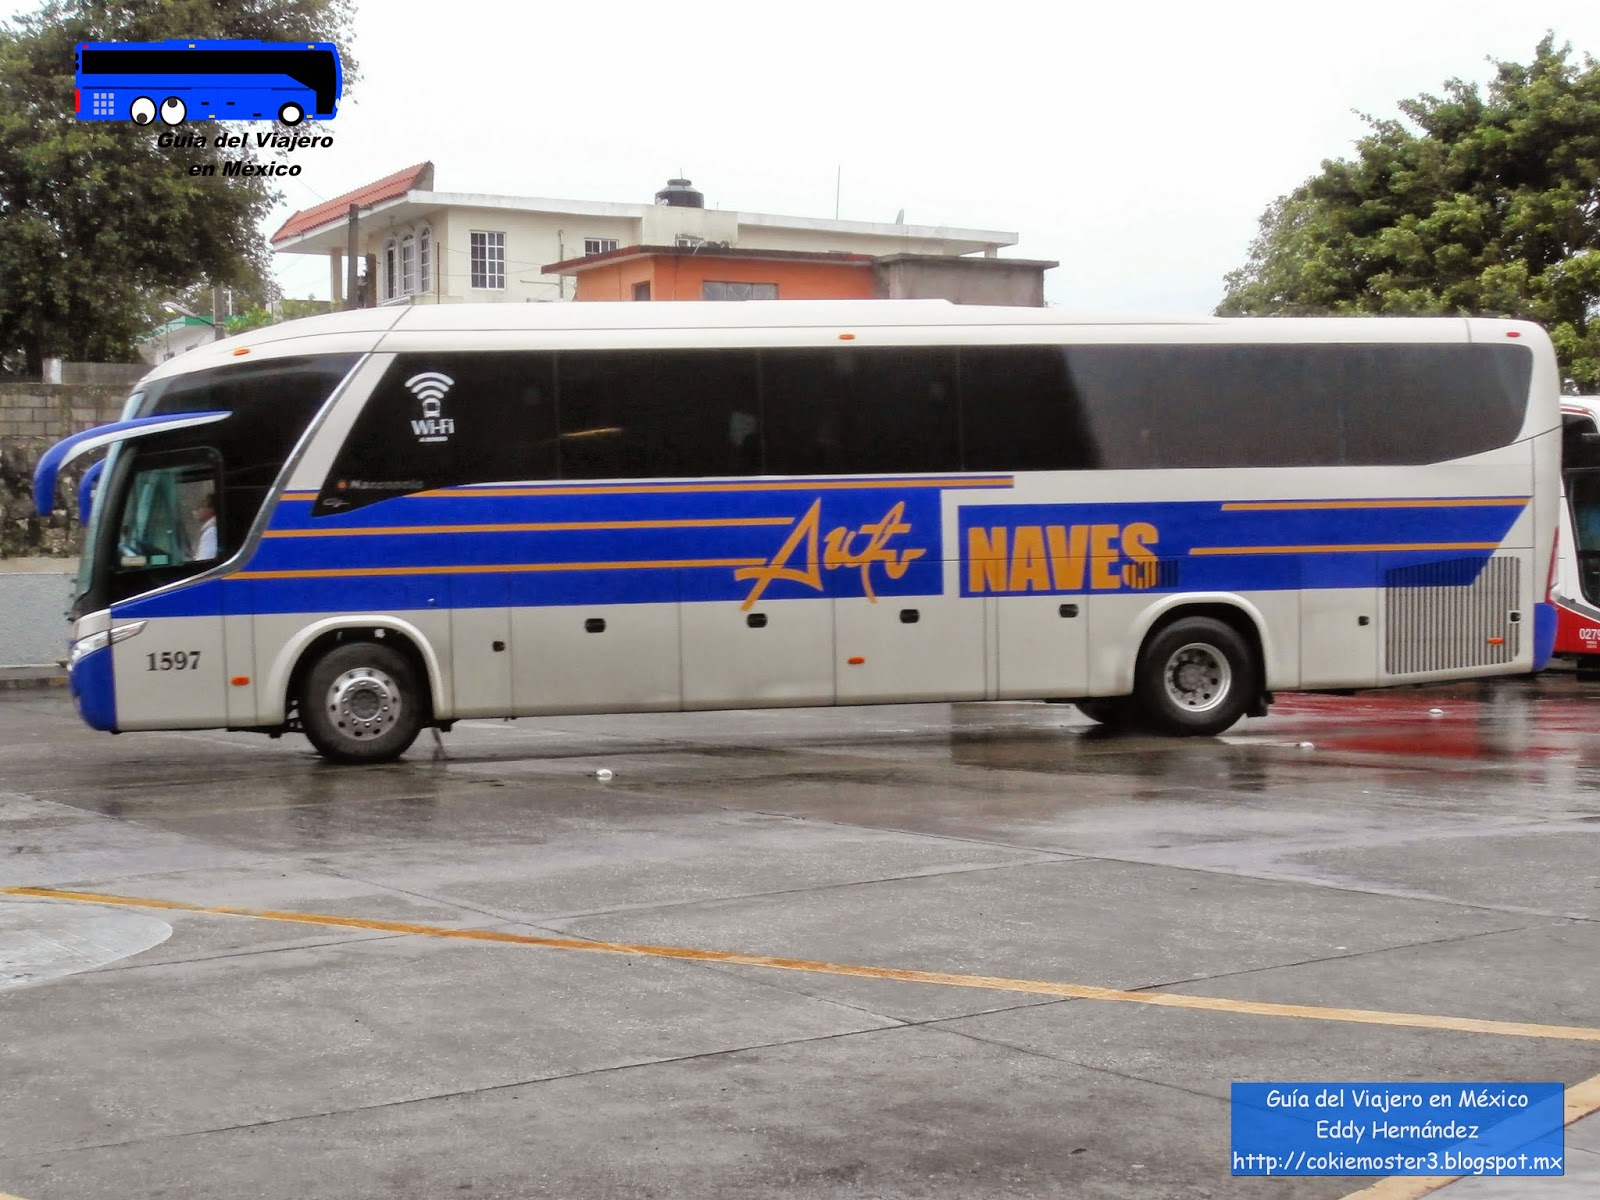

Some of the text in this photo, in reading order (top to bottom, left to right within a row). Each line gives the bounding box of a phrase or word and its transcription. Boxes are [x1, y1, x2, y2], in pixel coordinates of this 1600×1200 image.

[410, 418, 455, 436] Wi-Fi
[967, 522, 1160, 593] NAVES
[146, 651, 201, 672] 1597
